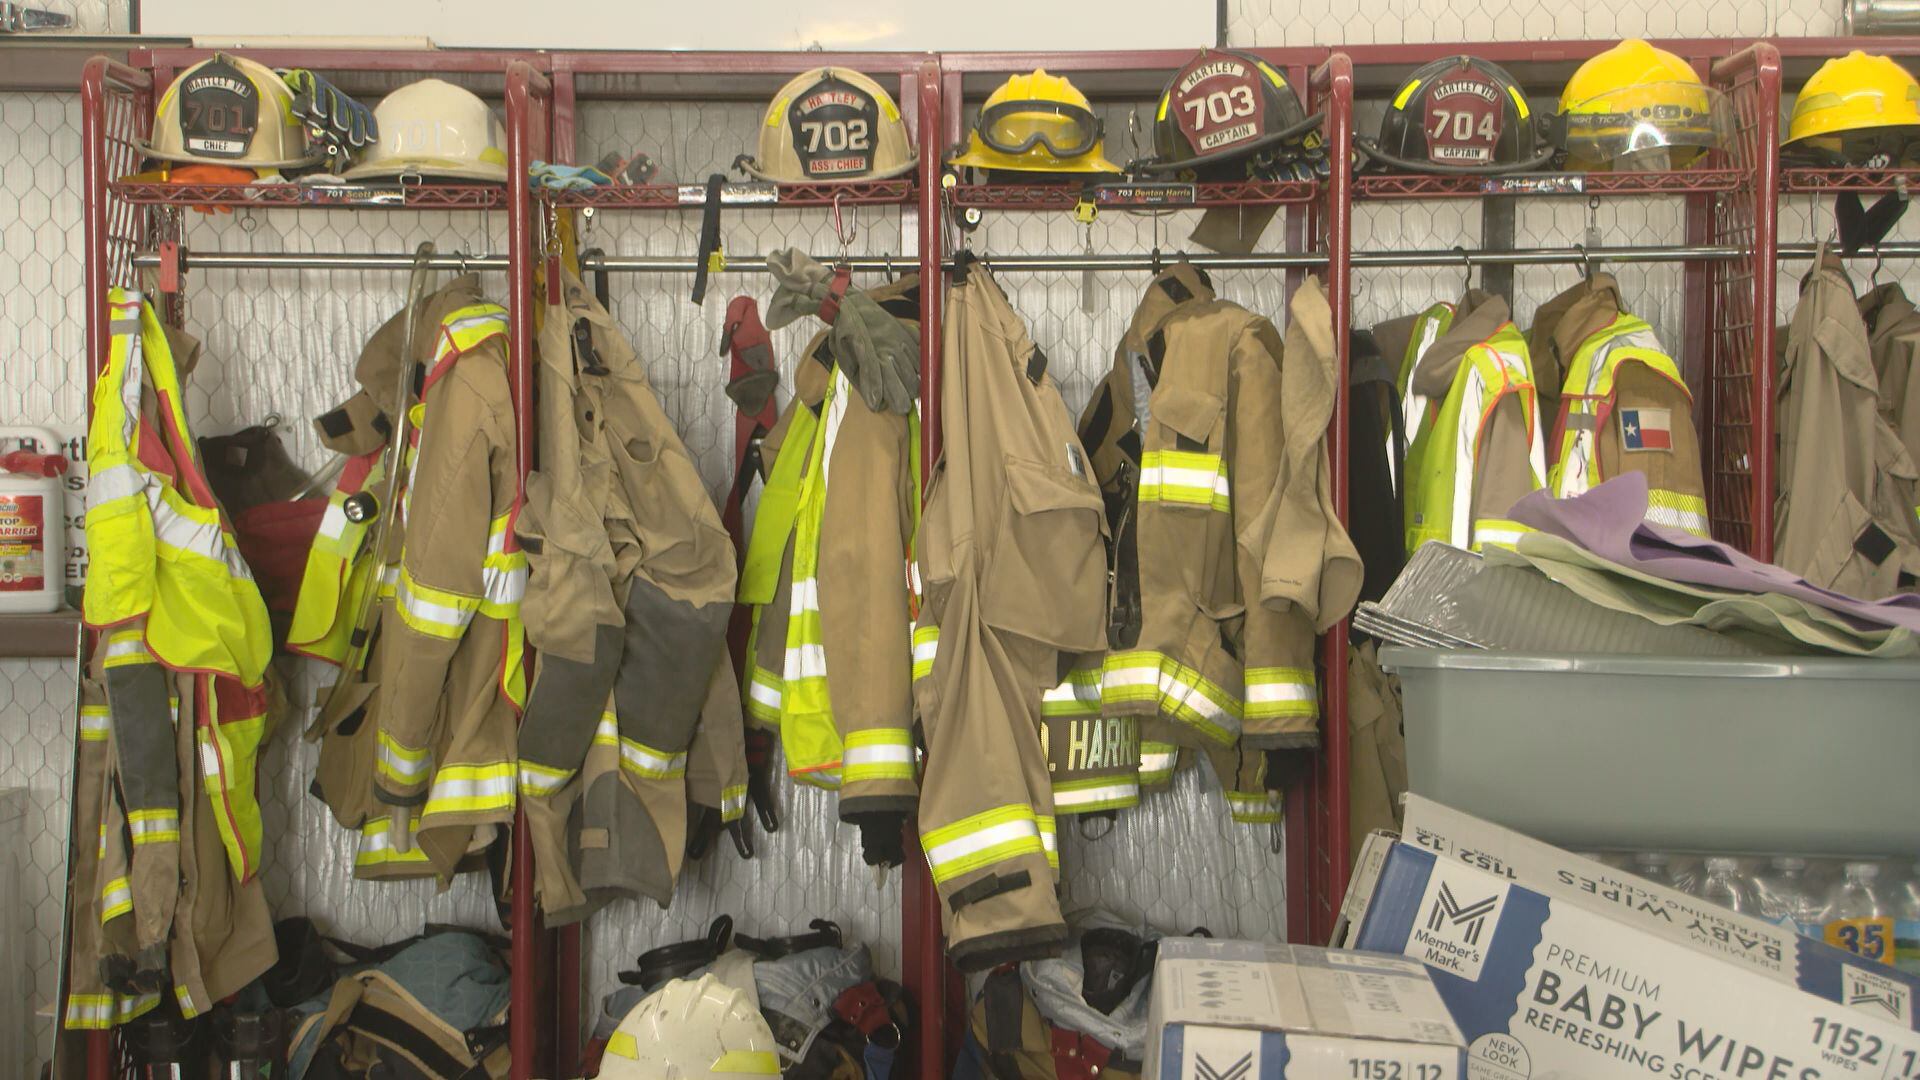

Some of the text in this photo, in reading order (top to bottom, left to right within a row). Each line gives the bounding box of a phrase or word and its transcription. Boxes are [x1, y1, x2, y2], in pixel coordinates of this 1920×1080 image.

[187, 77, 229, 92] HARTLEY
[1187, 63, 1236, 86] HARTLEY
[808, 92, 857, 109] HATLEY
[1437, 82, 1479, 98] HARTLEY
[185, 101, 249, 134] 701
[1184, 85, 1257, 131] 703
[801, 119, 869, 153] 702
[1205, 124, 1250, 147] CAPTAIN
[1433, 110, 1497, 142] 704
[203, 140, 229, 151] CHIEF
[1443, 148, 1481, 159] CAPTAIN
[837, 158, 865, 170] CHIEF
[327, 190, 343, 198] 701
[1118, 189, 1133, 197] 703
[1416, 833, 1517, 879] 1152 12
[1557, 869, 1781, 961] BABY WIPES
[1600, 876, 1781, 947] REFRESHING SCENT
[1414, 929, 1480, 963] Member's
[1690, 931, 1781, 972] PREMIUM
[1838, 924, 1885, 960] 35
[1425, 948, 1461, 970] Mark
[1547, 944, 1661, 1001] PREMIUM
[1533, 969, 1662, 1040] BABY
[1489, 1038, 1519, 1055] NEW
[1525, 1008, 1664, 1072] REFRESHING
[1812, 1017, 1882, 1065] 1152
[1349, 1058, 1443, 1080] 1152 12
[1482, 1048, 1518, 1068] LOOK
[1822, 1050, 1858, 1071] WIPES
